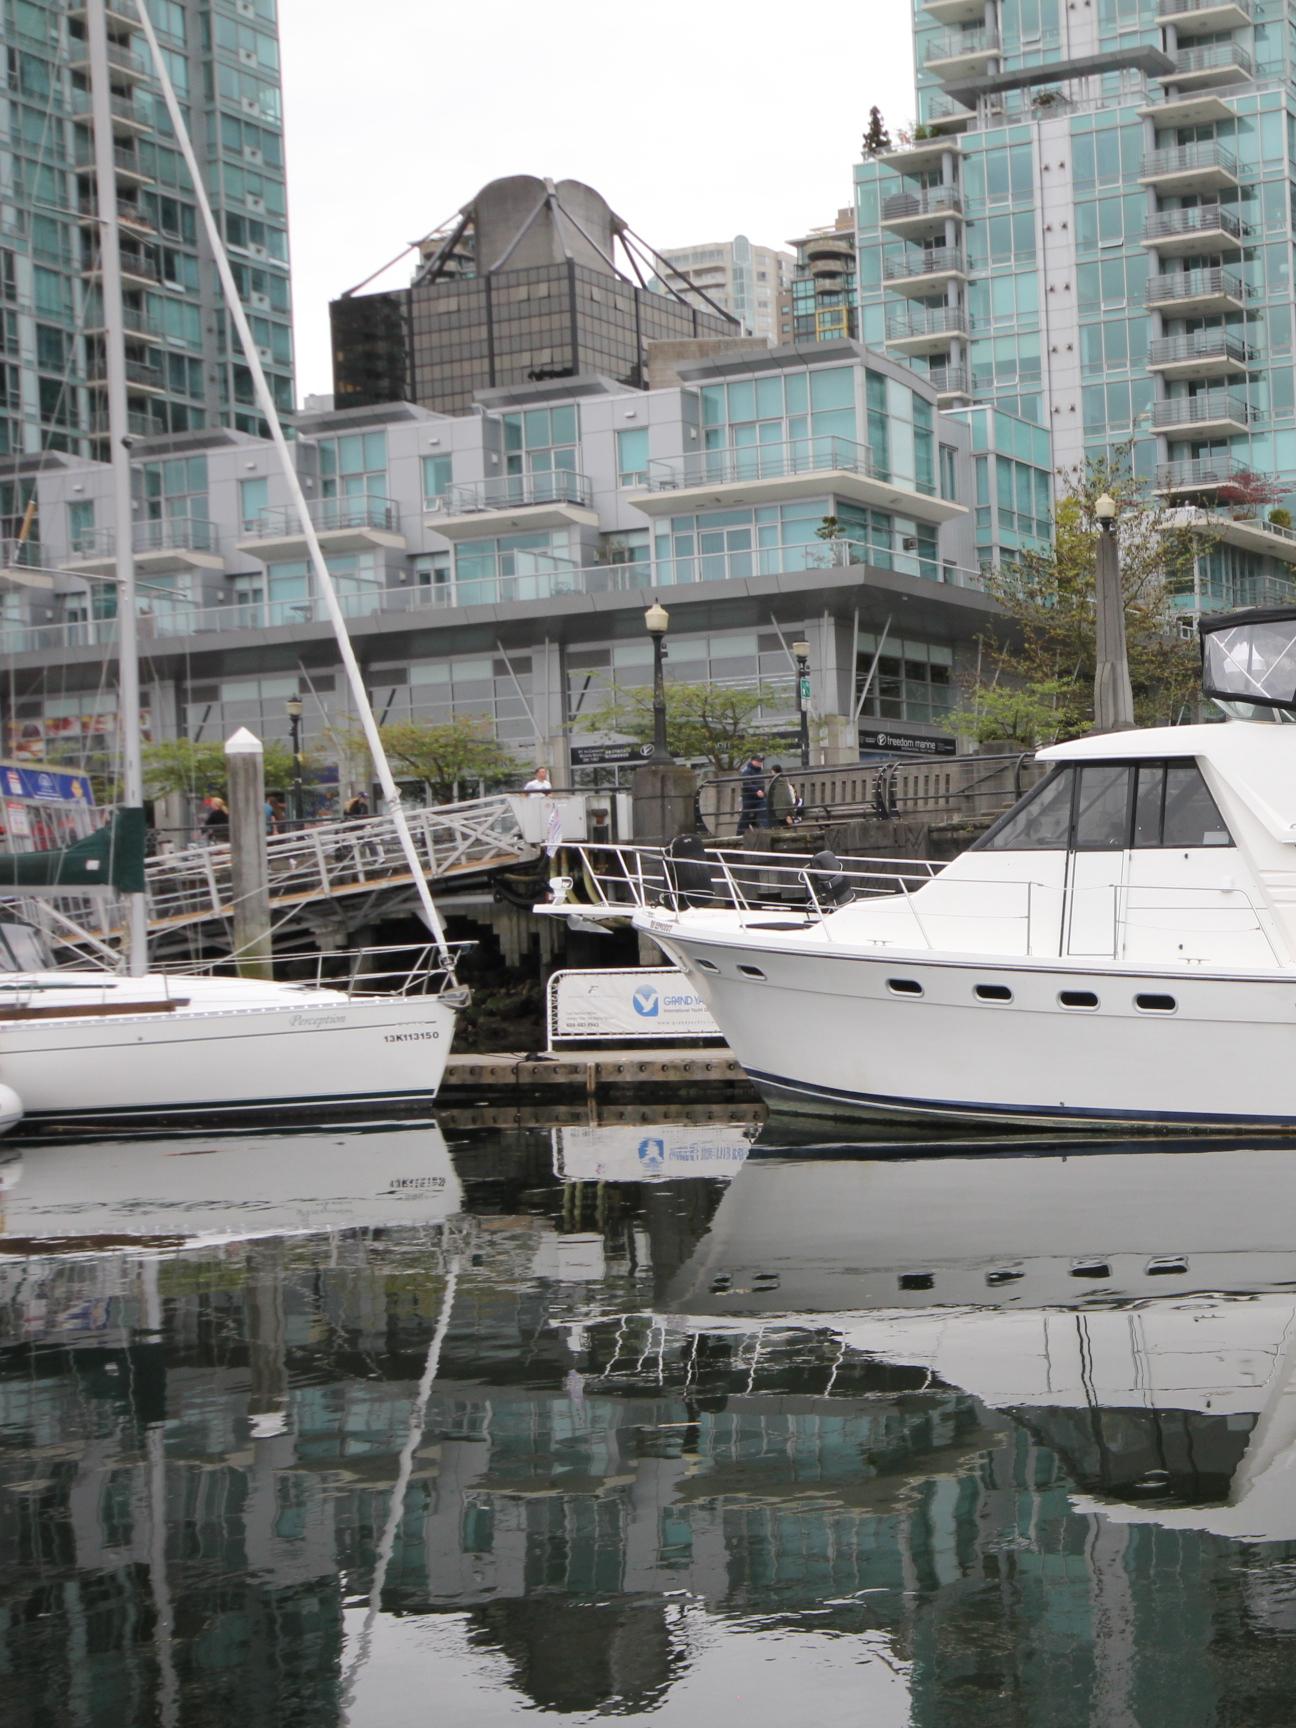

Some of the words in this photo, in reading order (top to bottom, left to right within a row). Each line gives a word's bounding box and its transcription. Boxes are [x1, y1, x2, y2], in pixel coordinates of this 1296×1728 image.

[887, 735, 914, 747] freedom
[915, 739, 936, 750] marine
[289, 1014, 347, 1028] Perception
[383, 1031, 440, 1043] 13K113150
